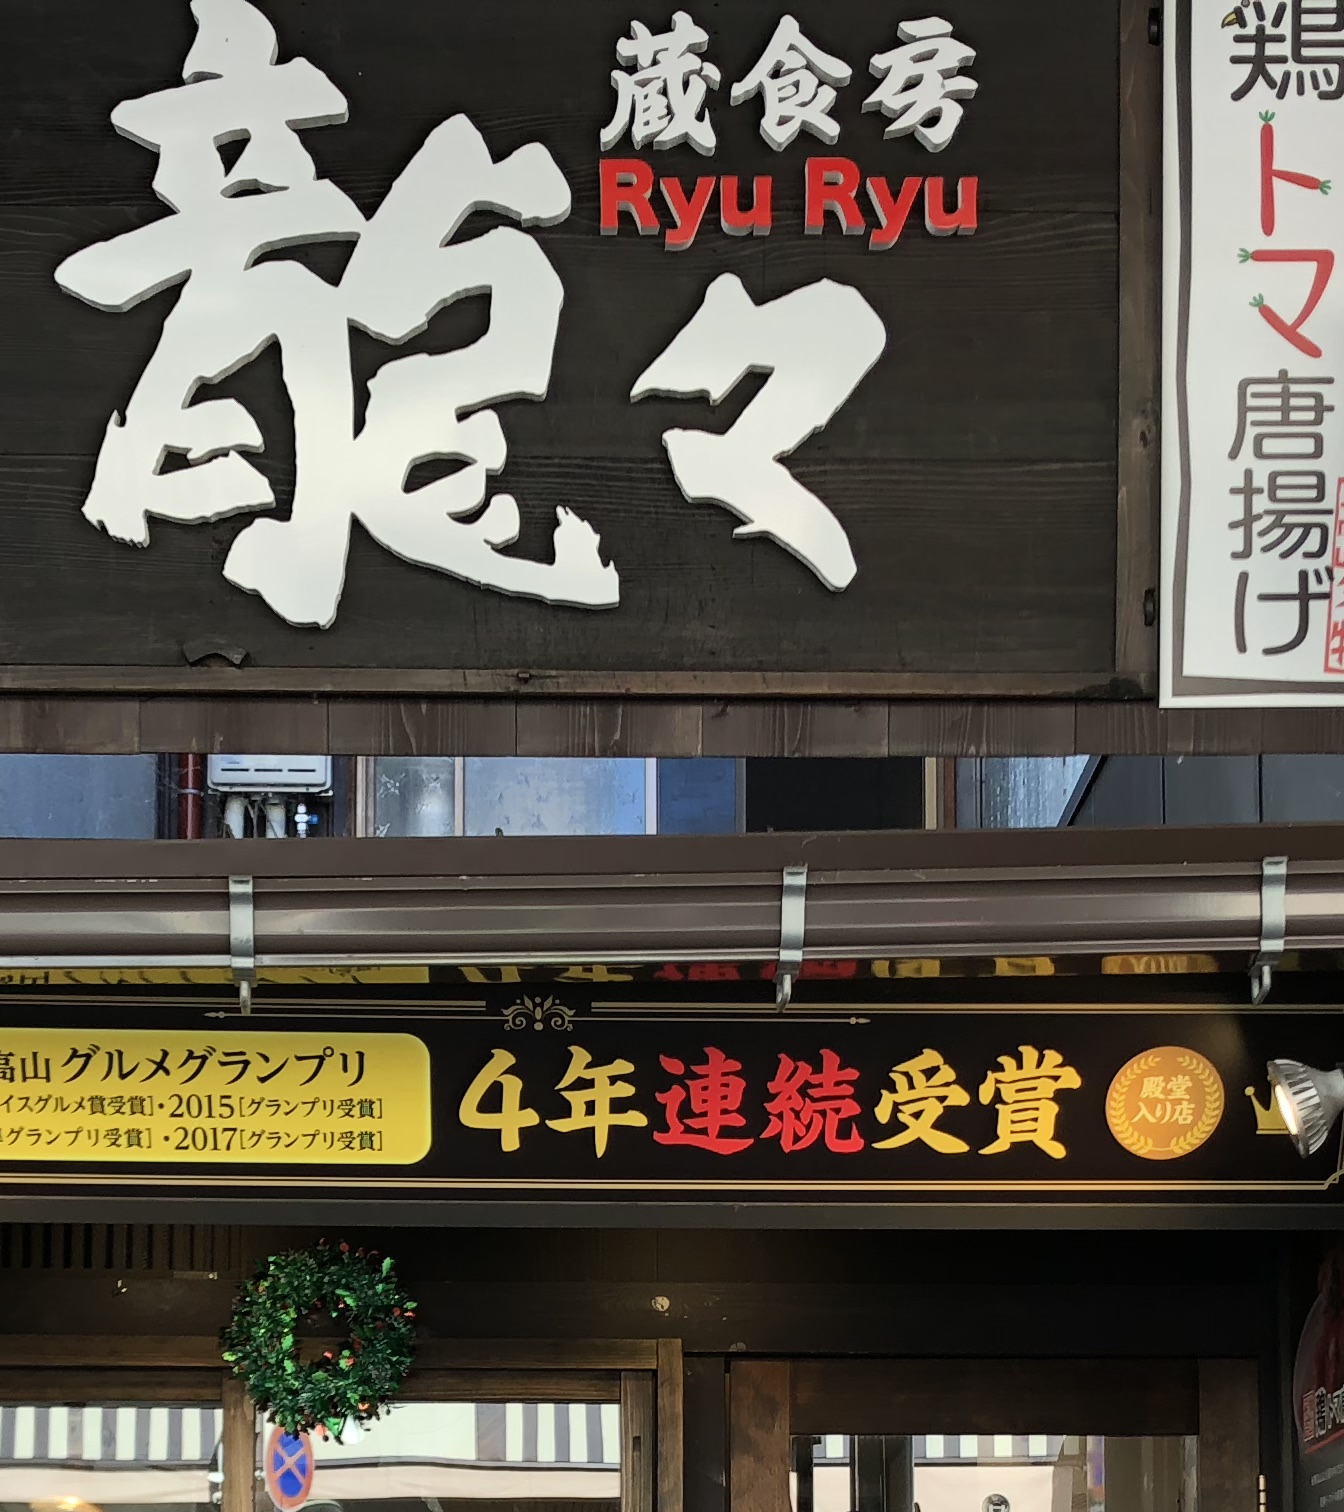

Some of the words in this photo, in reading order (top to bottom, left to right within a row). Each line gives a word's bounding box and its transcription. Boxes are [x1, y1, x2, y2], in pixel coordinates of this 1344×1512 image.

[600, 14, 979, 155] 蔵食房
[599, 158, 771, 251] Ryu
[804, 157, 980, 251] Ryu
[55, 0, 888, 630] 龍々
[459, 1043, 1082, 1160] 4年連続受賞
[1131, 1101, 1196, 1125] 入り店
[1139, 1075, 1193, 1100] 殿堂
